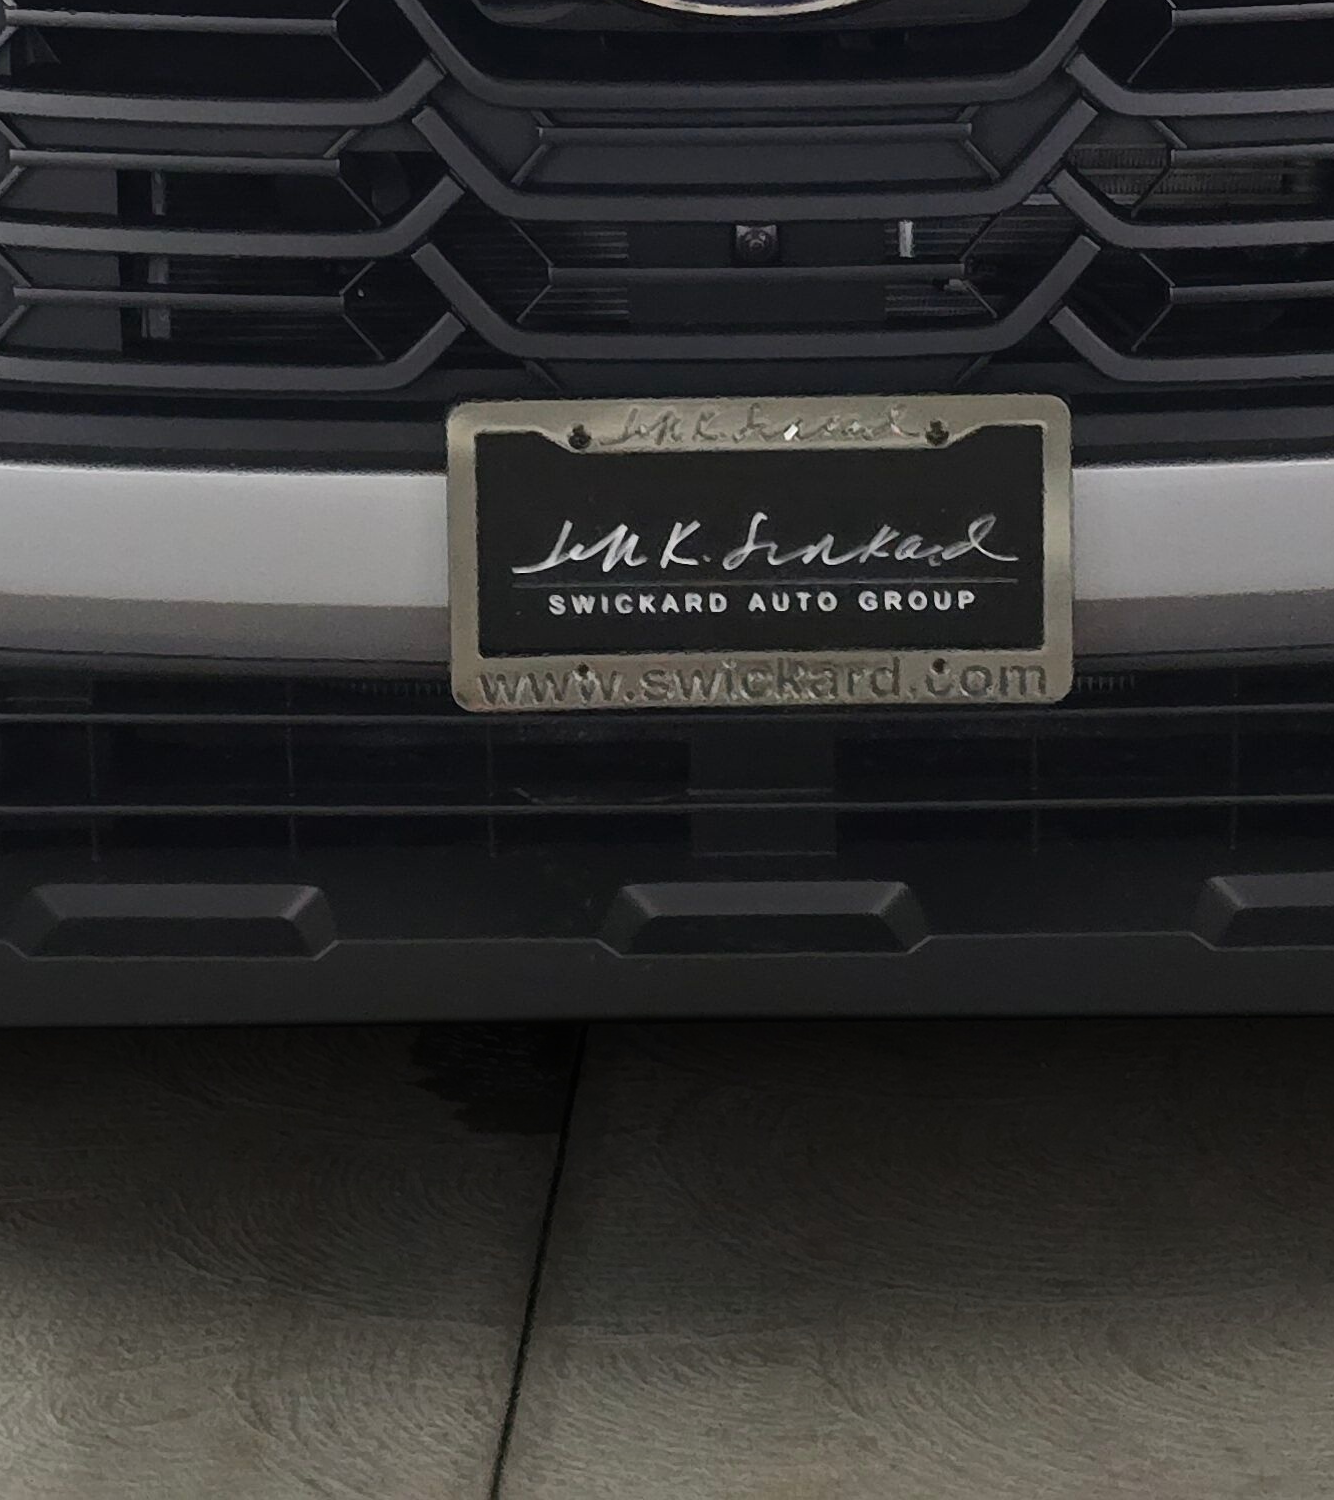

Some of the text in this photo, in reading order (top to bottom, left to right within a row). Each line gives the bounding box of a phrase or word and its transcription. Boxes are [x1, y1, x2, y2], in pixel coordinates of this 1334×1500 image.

[548, 589, 975, 615] SWICKARD AUTO GROUP
[478, 656, 1047, 704] www.swickard.com
